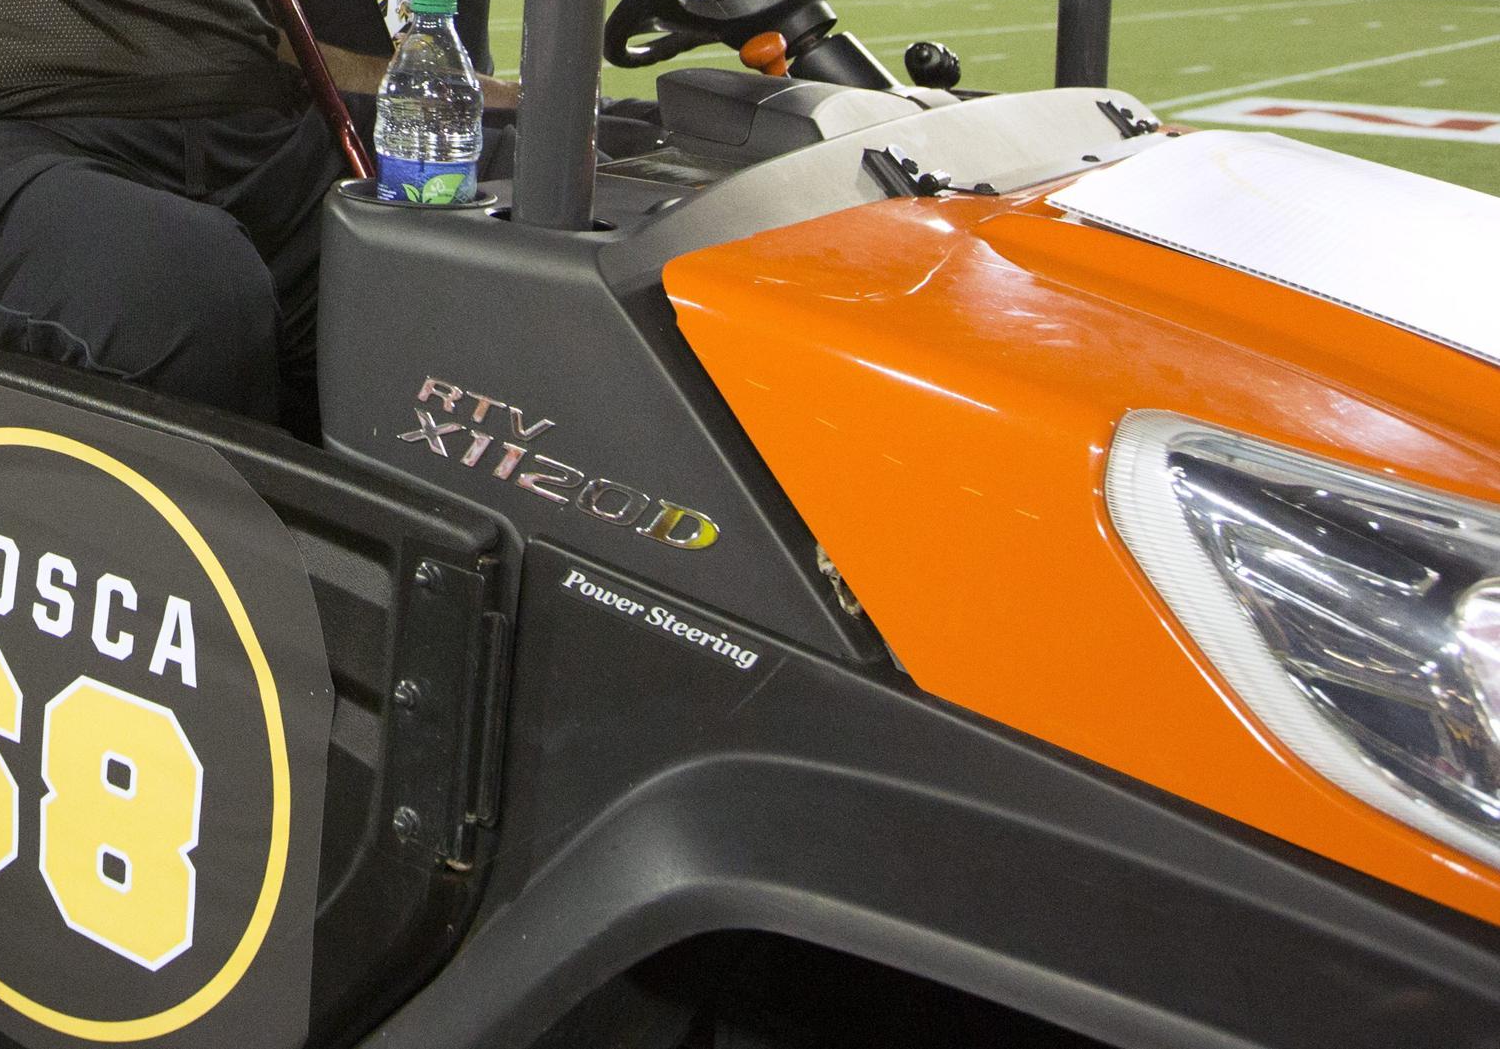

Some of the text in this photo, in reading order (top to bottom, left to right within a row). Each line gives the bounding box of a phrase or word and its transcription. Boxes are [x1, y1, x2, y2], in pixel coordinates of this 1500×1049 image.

[416, 375, 556, 442] RTV
[397, 407, 720, 550] X1120D
[561, 569, 759, 670] Power Steering
